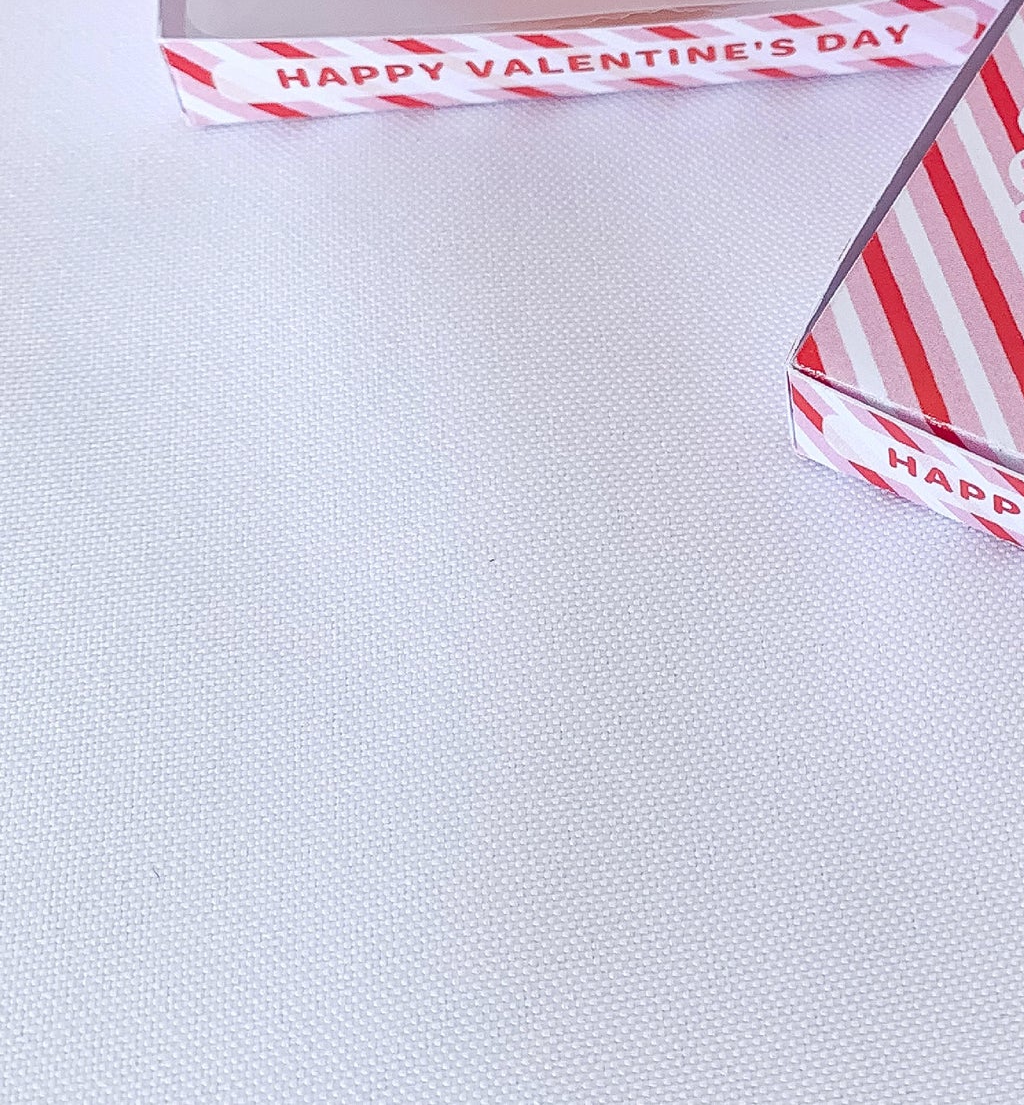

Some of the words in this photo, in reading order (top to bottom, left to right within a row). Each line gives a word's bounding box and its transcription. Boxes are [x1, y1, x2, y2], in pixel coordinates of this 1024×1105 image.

[276, 62, 445, 90] HAPPY
[464, 39, 797, 80] VALENTINE'S
[815, 24, 912, 53] DAY
